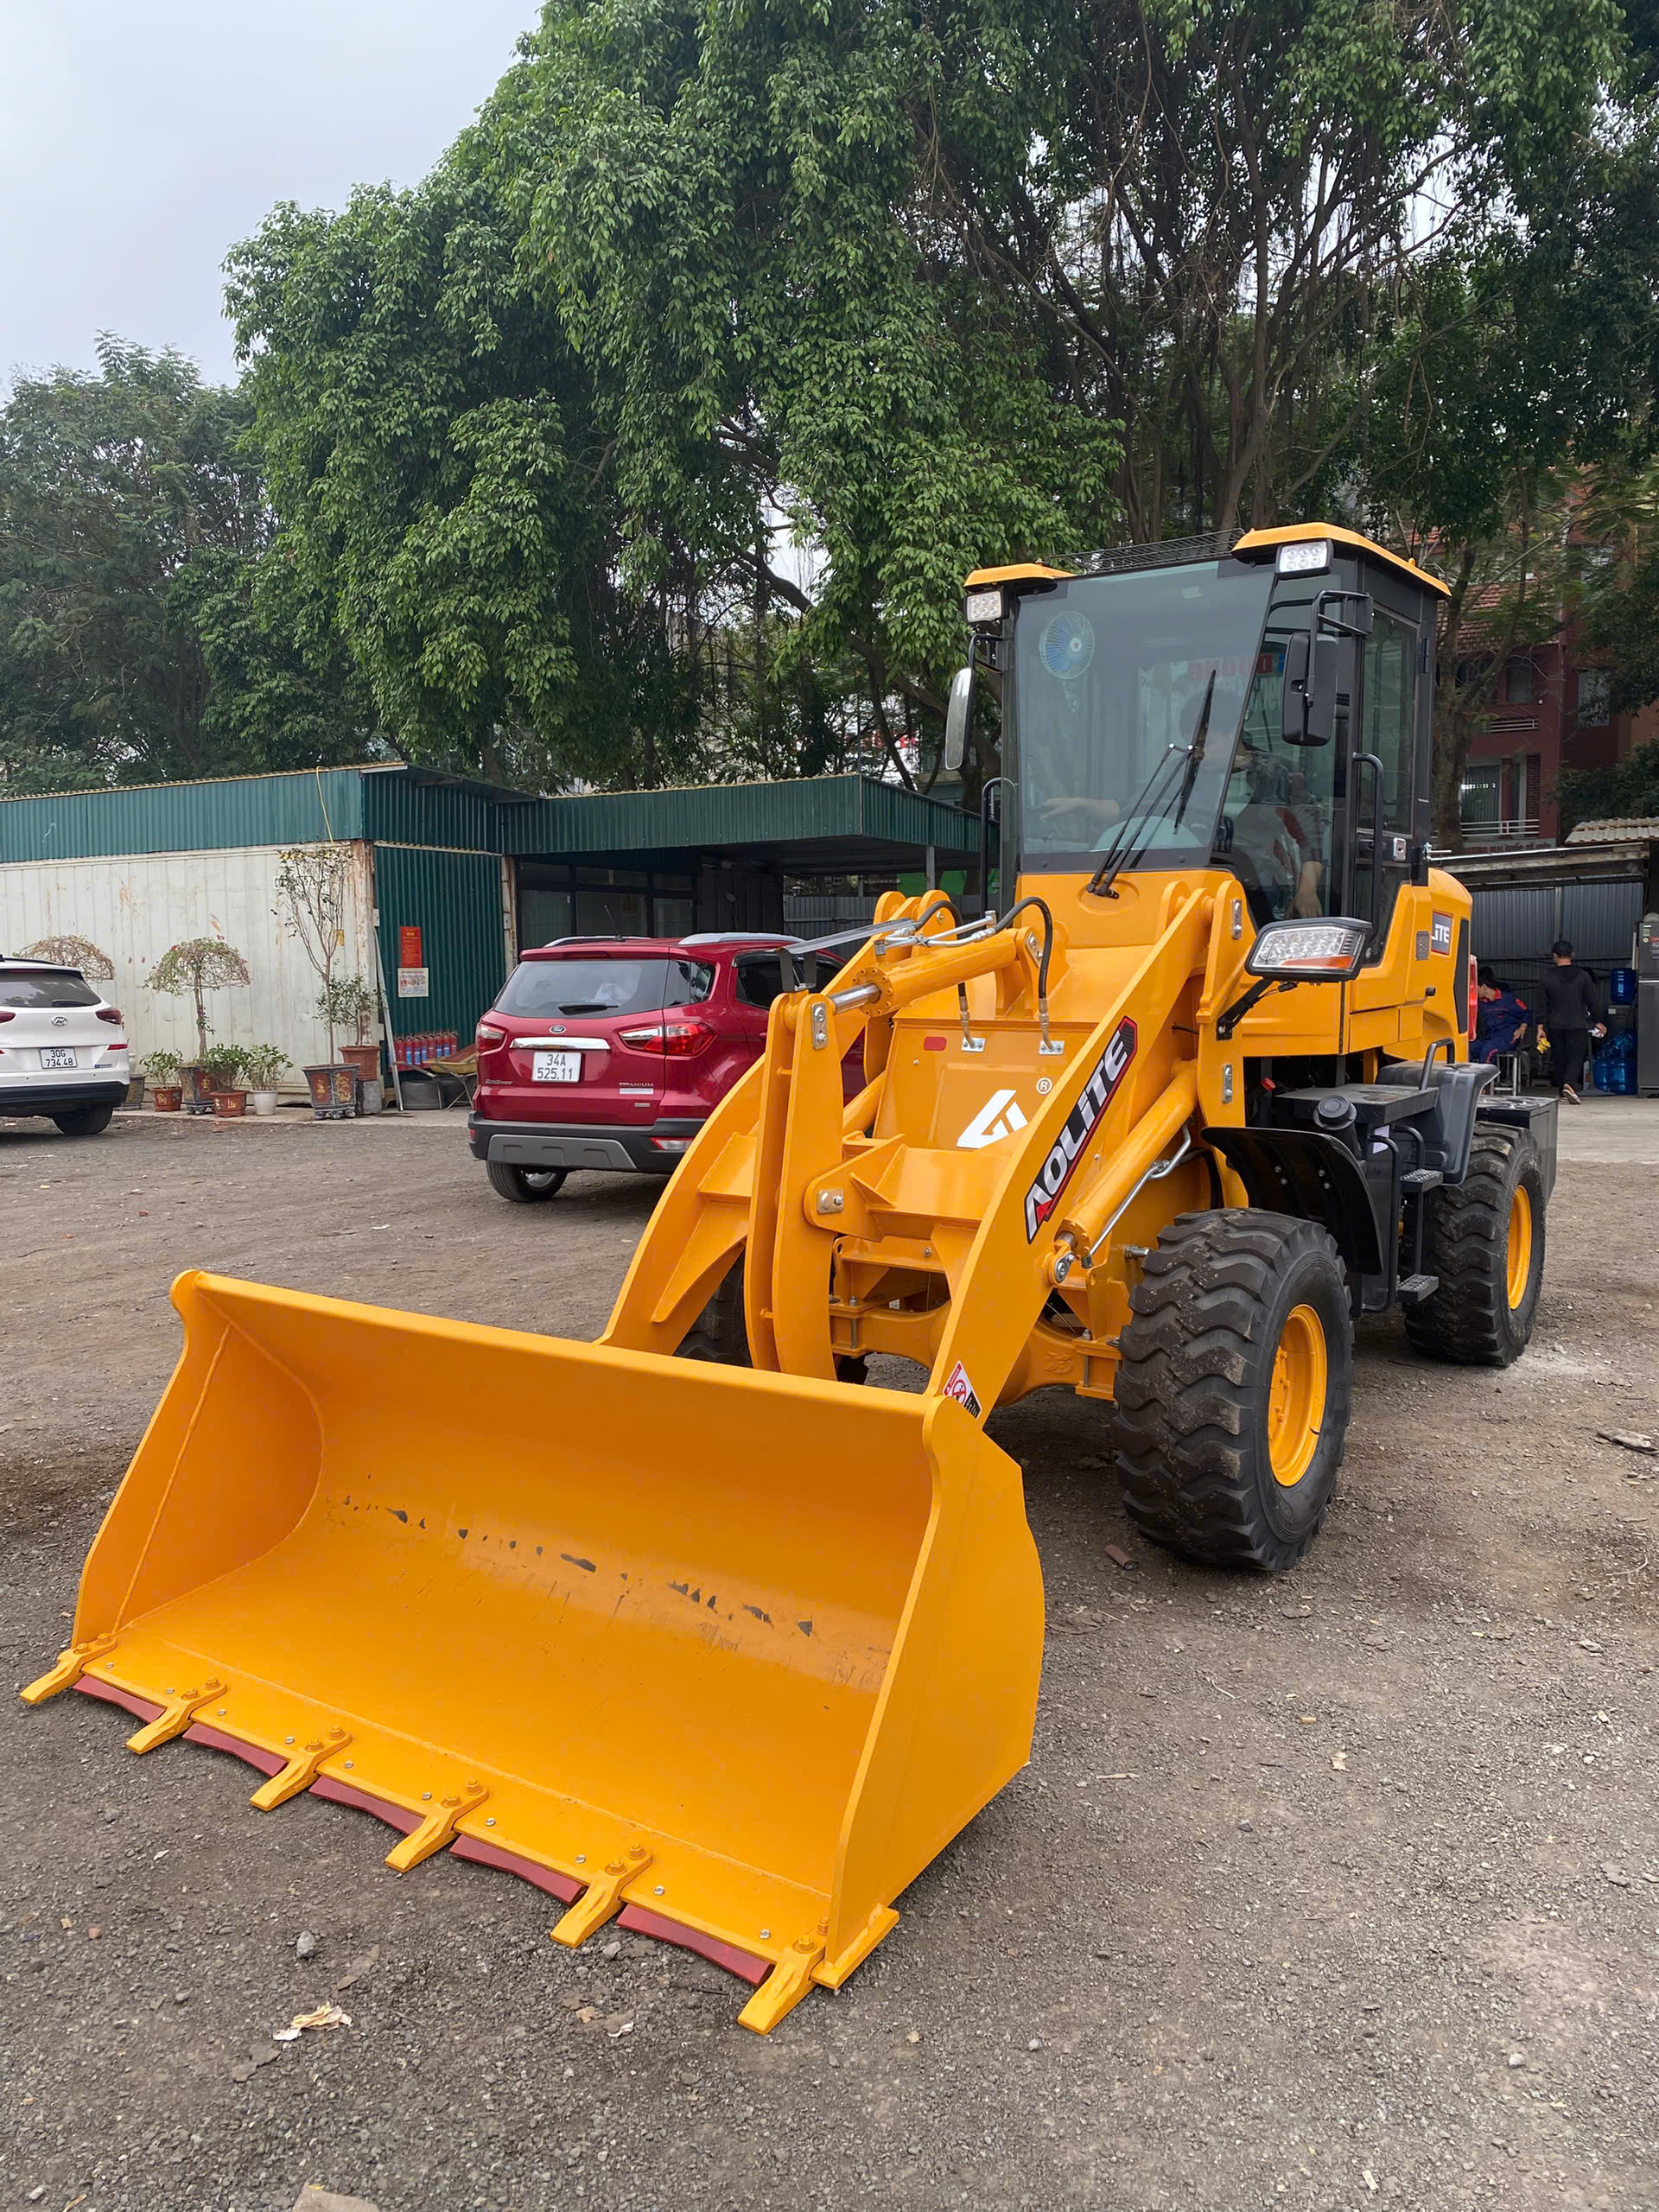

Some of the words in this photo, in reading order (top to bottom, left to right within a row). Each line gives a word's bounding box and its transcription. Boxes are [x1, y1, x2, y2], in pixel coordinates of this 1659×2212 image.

[45, 1058, 73, 1067] 734.48
[546, 1054, 566, 1066] 34A
[537, 1068, 573, 1080] 525.11
